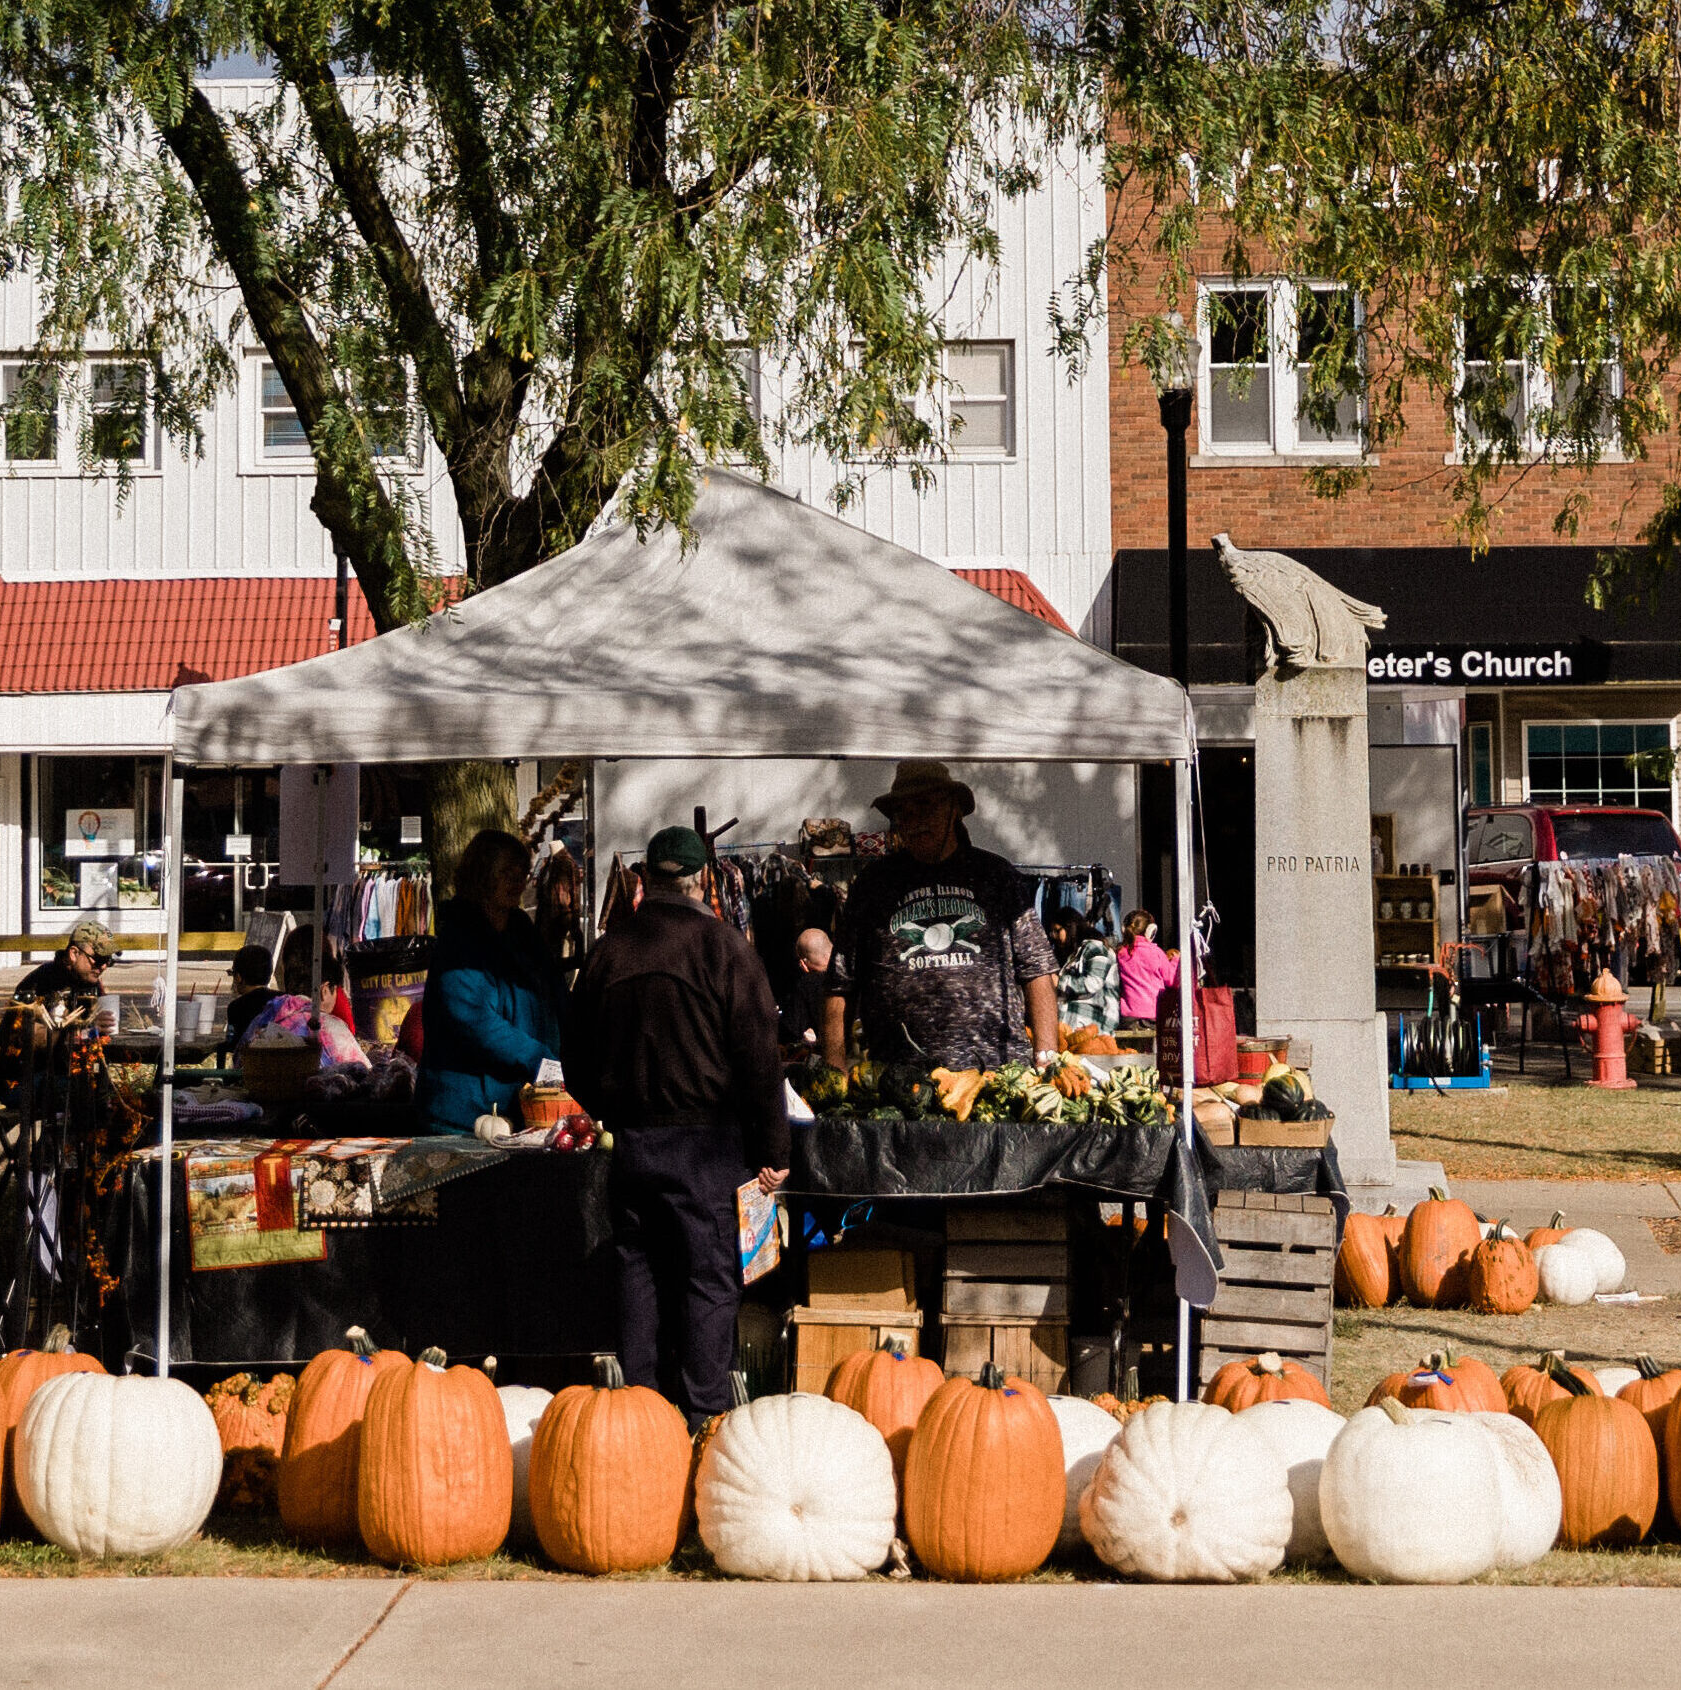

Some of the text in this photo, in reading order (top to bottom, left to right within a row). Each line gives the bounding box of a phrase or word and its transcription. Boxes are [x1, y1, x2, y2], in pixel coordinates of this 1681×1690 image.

[1368, 650, 1573, 678] eter's Church
[1267, 855, 1360, 873] PRO PATRIA
[908, 952, 974, 970] SOFTBALL
